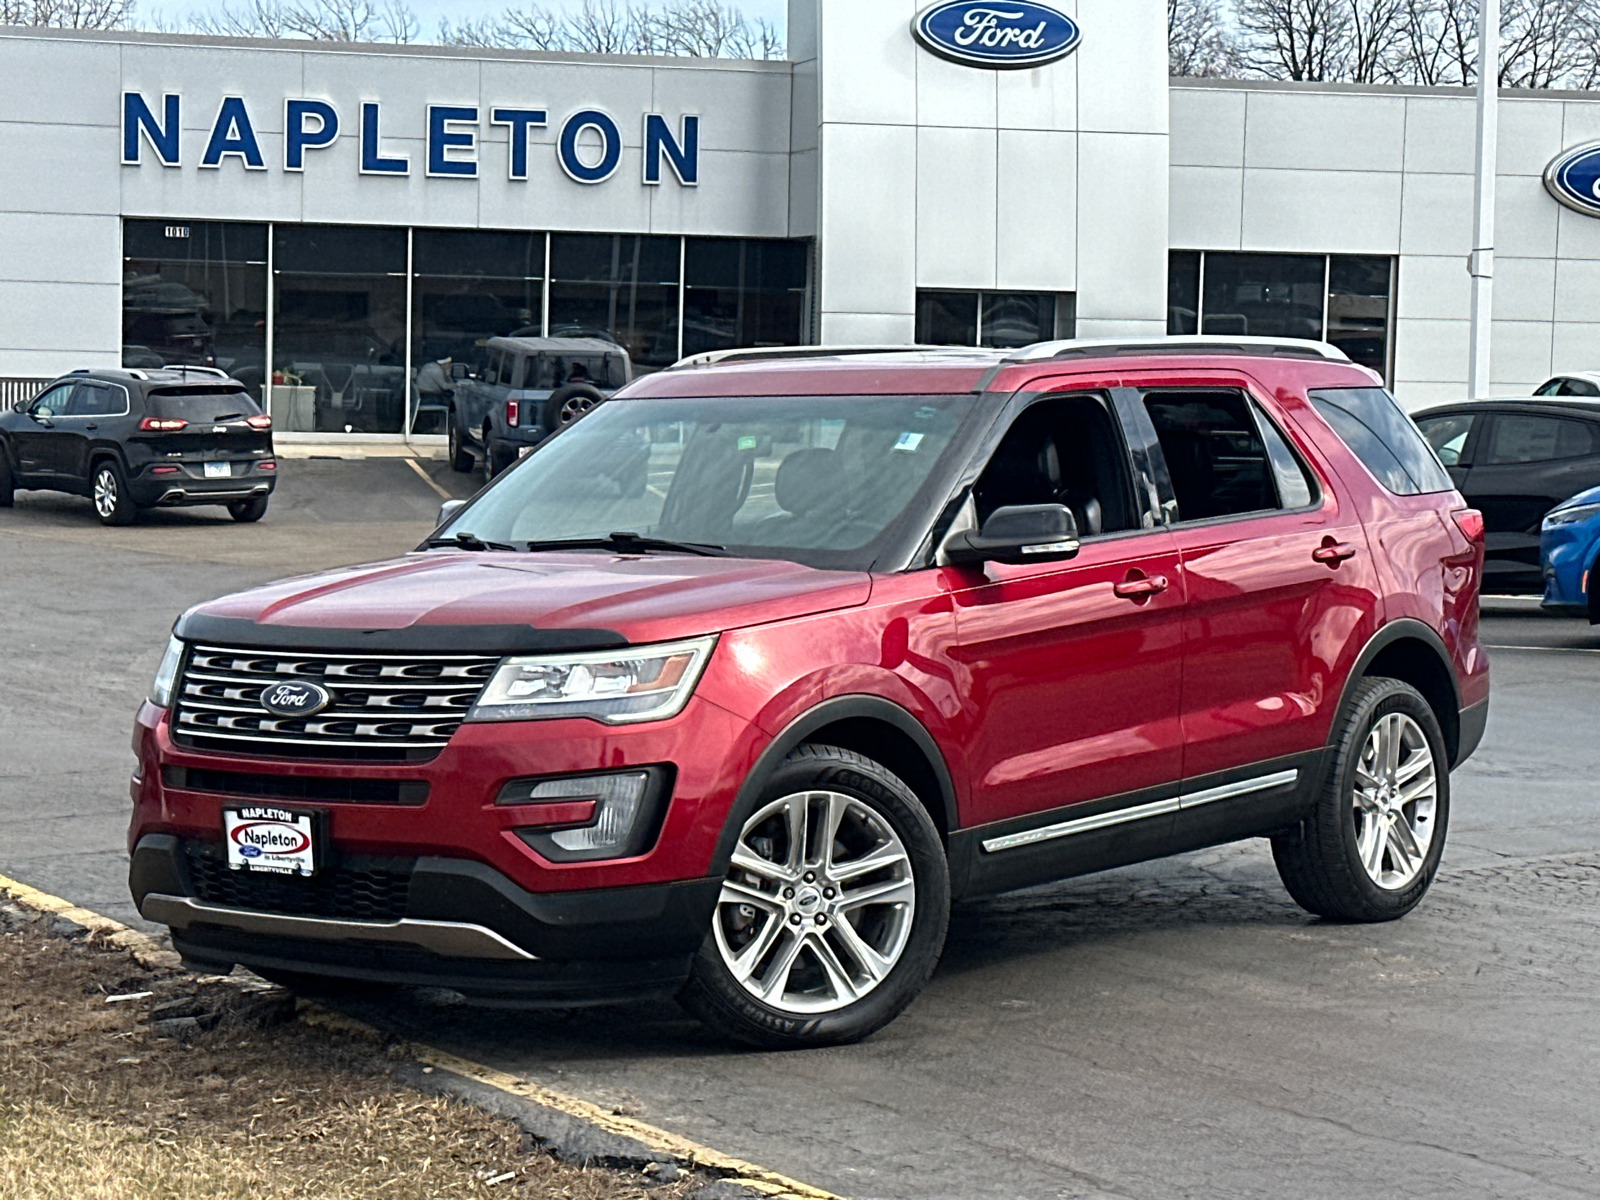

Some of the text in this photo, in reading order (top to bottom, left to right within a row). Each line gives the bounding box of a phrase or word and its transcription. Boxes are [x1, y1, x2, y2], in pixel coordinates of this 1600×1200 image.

[954, 8, 1047, 48] Ford
[120, 91, 700, 186] NAPLETON
[270, 685, 310, 706] Ford
[241, 807, 292, 822] NAPLETON
[244, 829, 298, 848] Napleton
